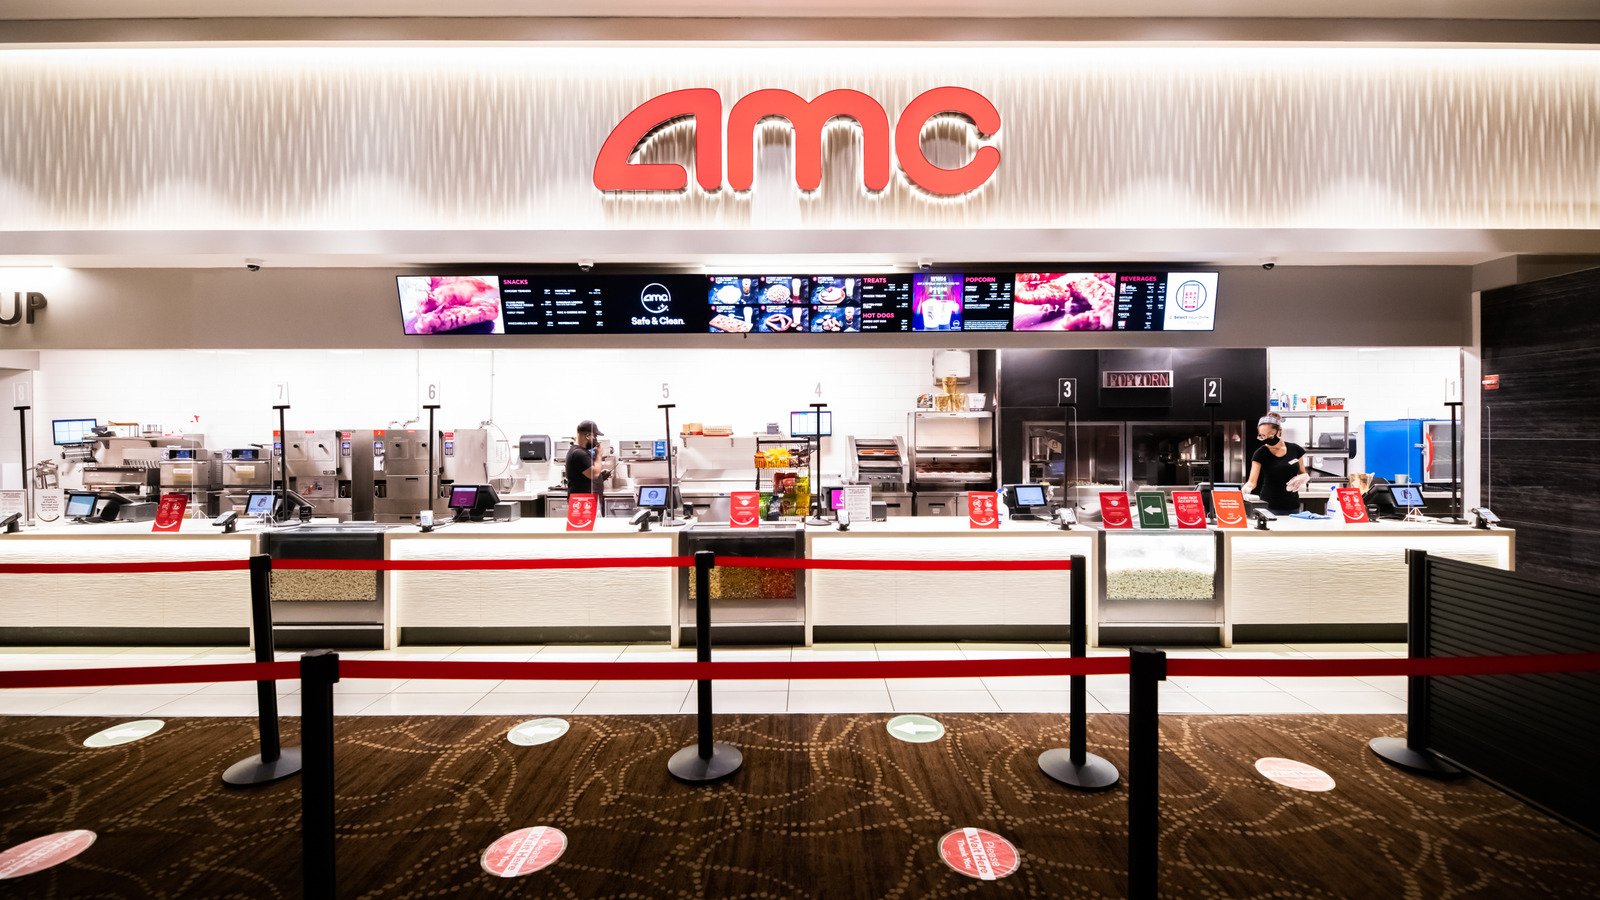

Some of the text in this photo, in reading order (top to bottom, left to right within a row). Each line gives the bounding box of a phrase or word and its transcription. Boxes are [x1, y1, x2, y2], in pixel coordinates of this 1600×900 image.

[631, 317, 650, 325] Safe
[652, 317, 658, 325] &
[1110, 374, 1168, 386] POPCORN
[18, 385, 24, 401] 8
[277, 384, 283, 400] 7
[428, 384, 436, 400] 6
[662, 383, 669, 398] 5
[815, 382, 822, 397] 4
[1064, 381, 1072, 398] 3
[1209, 381, 1216, 397] 2
[1451, 381, 1455, 396] 1
[496, 837, 524, 867] Thank You
[507, 833, 540, 871] Wait Here
[527, 839, 550, 864] Please
[957, 839, 971, 869] Thank You
[968, 834, 988, 874] Wait Here
[984, 841, 1000, 867] Please
